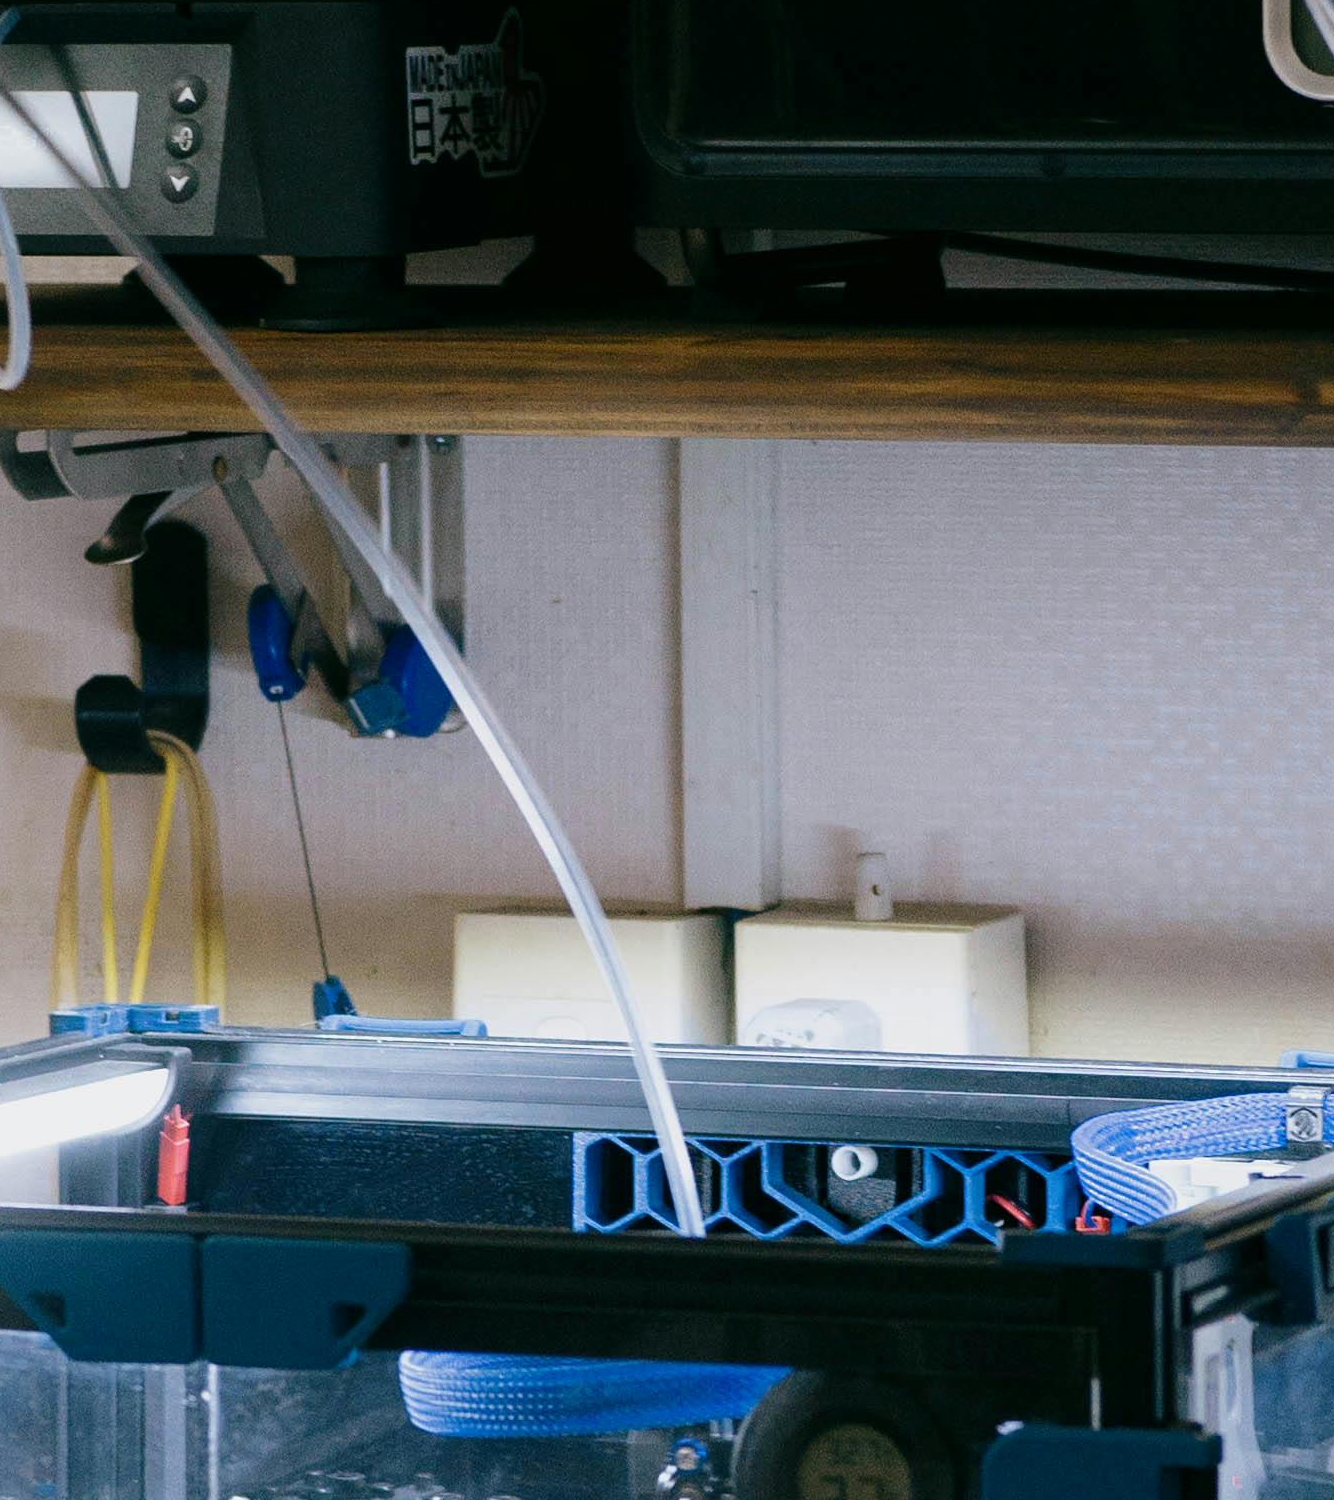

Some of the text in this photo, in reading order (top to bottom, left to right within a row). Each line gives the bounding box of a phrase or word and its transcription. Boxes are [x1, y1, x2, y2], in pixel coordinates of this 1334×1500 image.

[408, 54, 445, 92] MADE
[410, 91, 504, 159] 日本製
